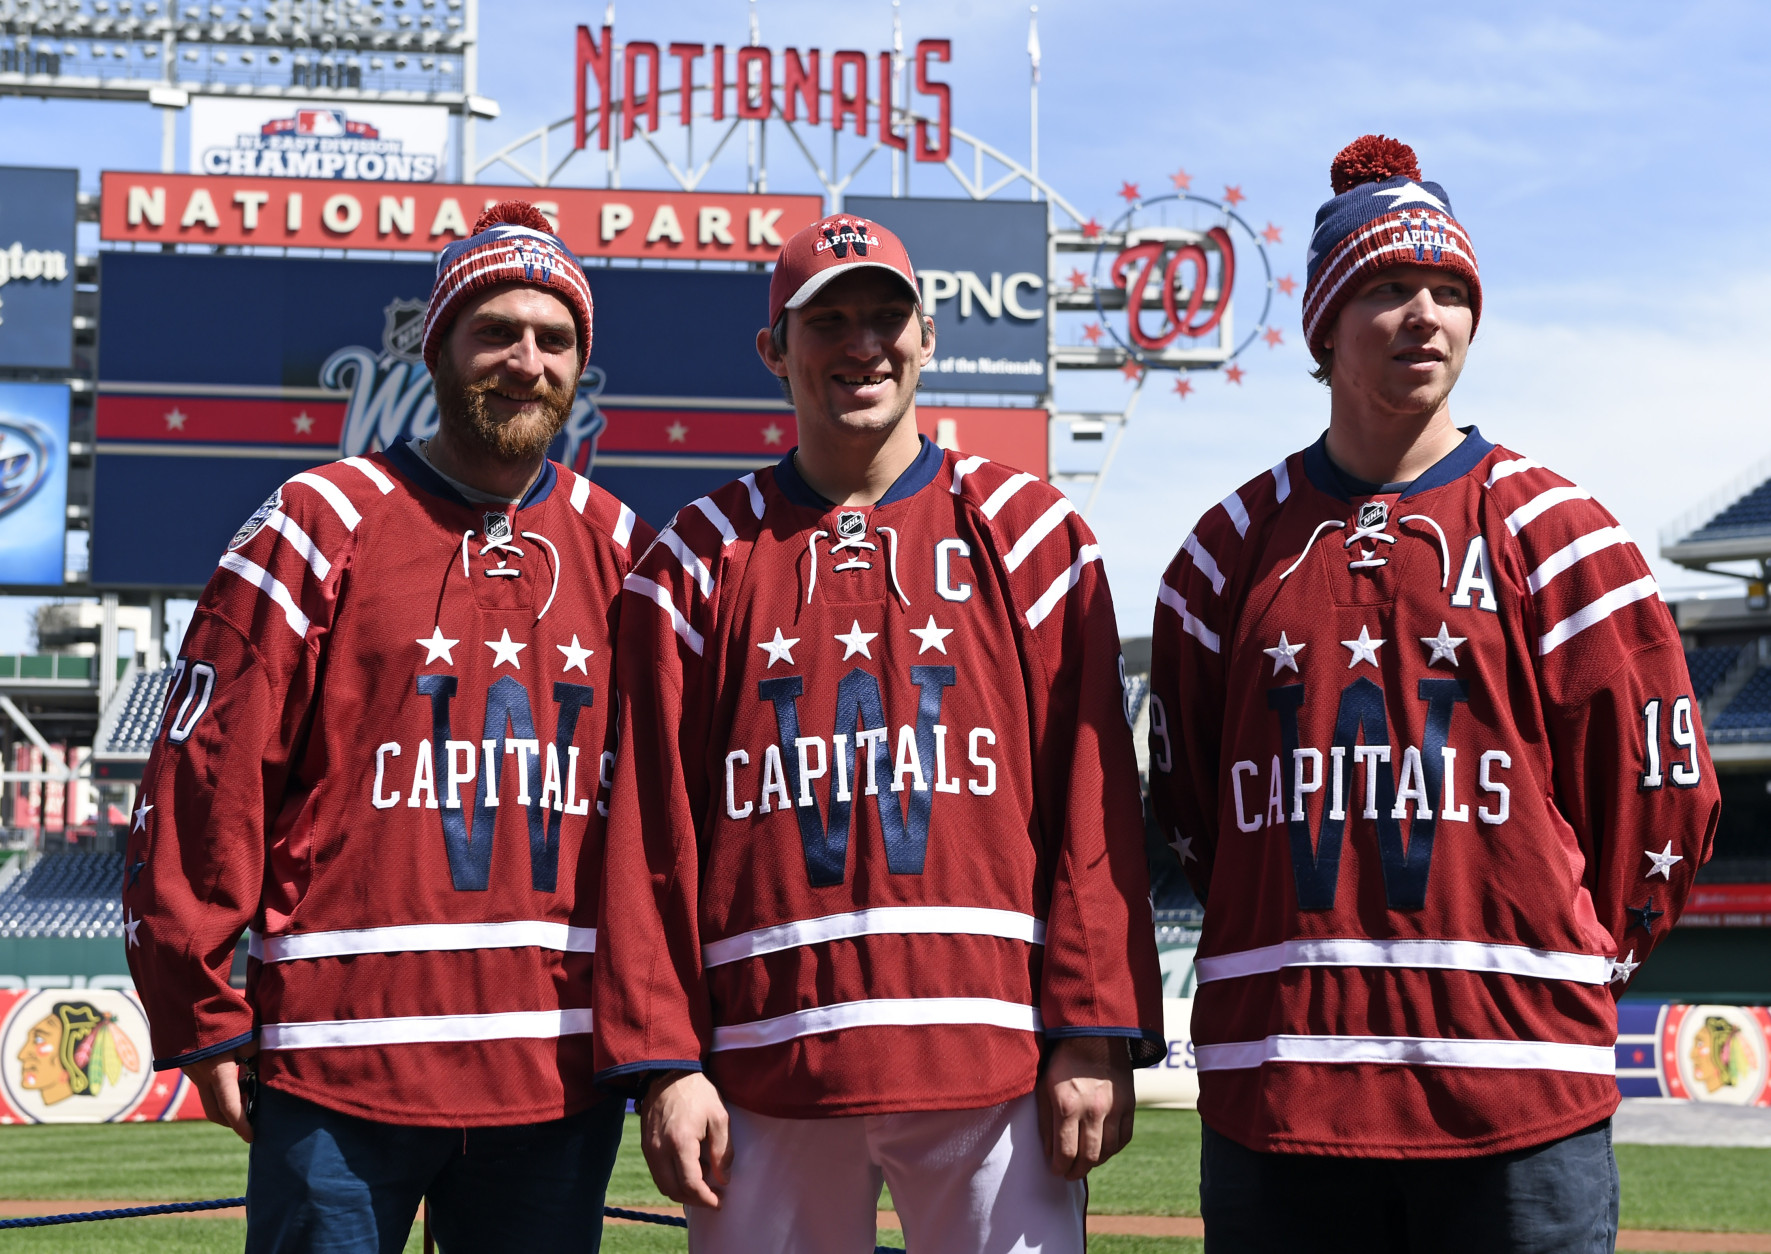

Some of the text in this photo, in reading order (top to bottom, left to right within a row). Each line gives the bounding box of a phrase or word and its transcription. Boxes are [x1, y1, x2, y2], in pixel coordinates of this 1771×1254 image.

[575, 24, 952, 163] NATIONALS
[203, 148, 437, 183] CHAMPIONS
[601, 203, 785, 246] PARK
[816, 232, 879, 252] CAPITALS
[1392, 229, 1457, 252] CAPITALS
[505, 251, 565, 276] CAPITALS
[1111, 226, 1235, 350] W
[915, 269, 1044, 320] PNC
[955, 356, 978, 374] the
[978, 357, 1044, 376] Nationals
[934, 537, 973, 603] C
[1450, 534, 1498, 612] A
[1641, 695, 1700, 789] 19
[725, 723, 997, 820] CAPITALS
[1231, 744, 1512, 834] CAPITALS
